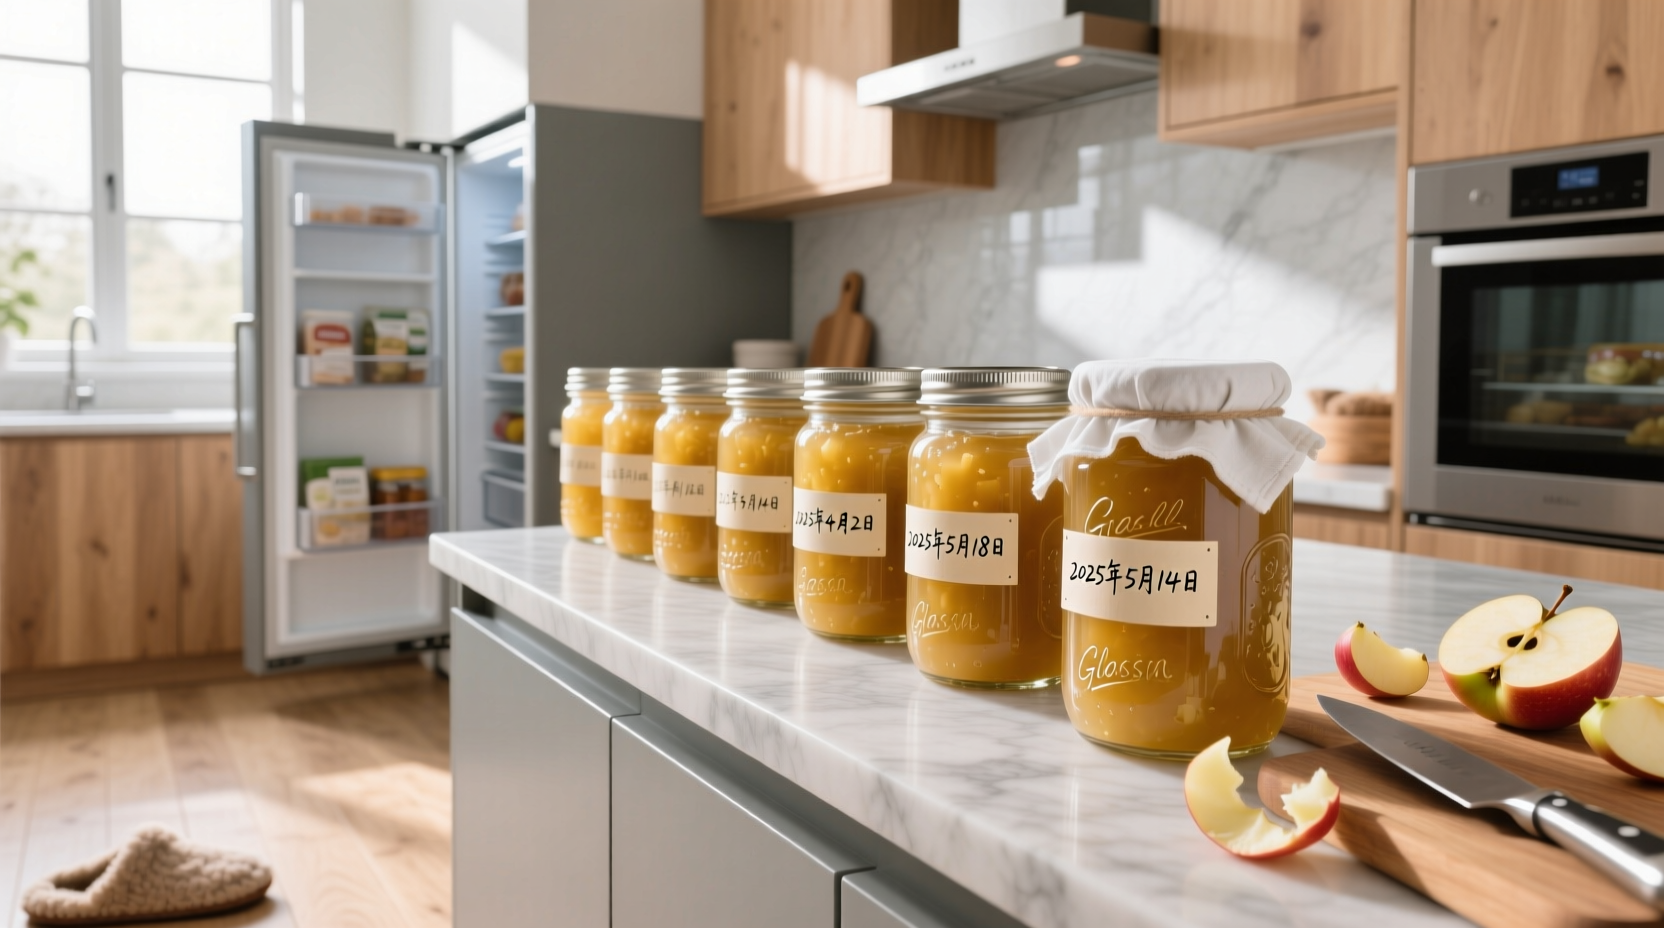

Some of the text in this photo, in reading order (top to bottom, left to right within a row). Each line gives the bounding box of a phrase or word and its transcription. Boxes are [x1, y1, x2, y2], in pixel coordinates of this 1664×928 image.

[907, 528, 1003, 560] 2025年5月18日
[1069, 559, 1198, 595] 2025年5月14日
